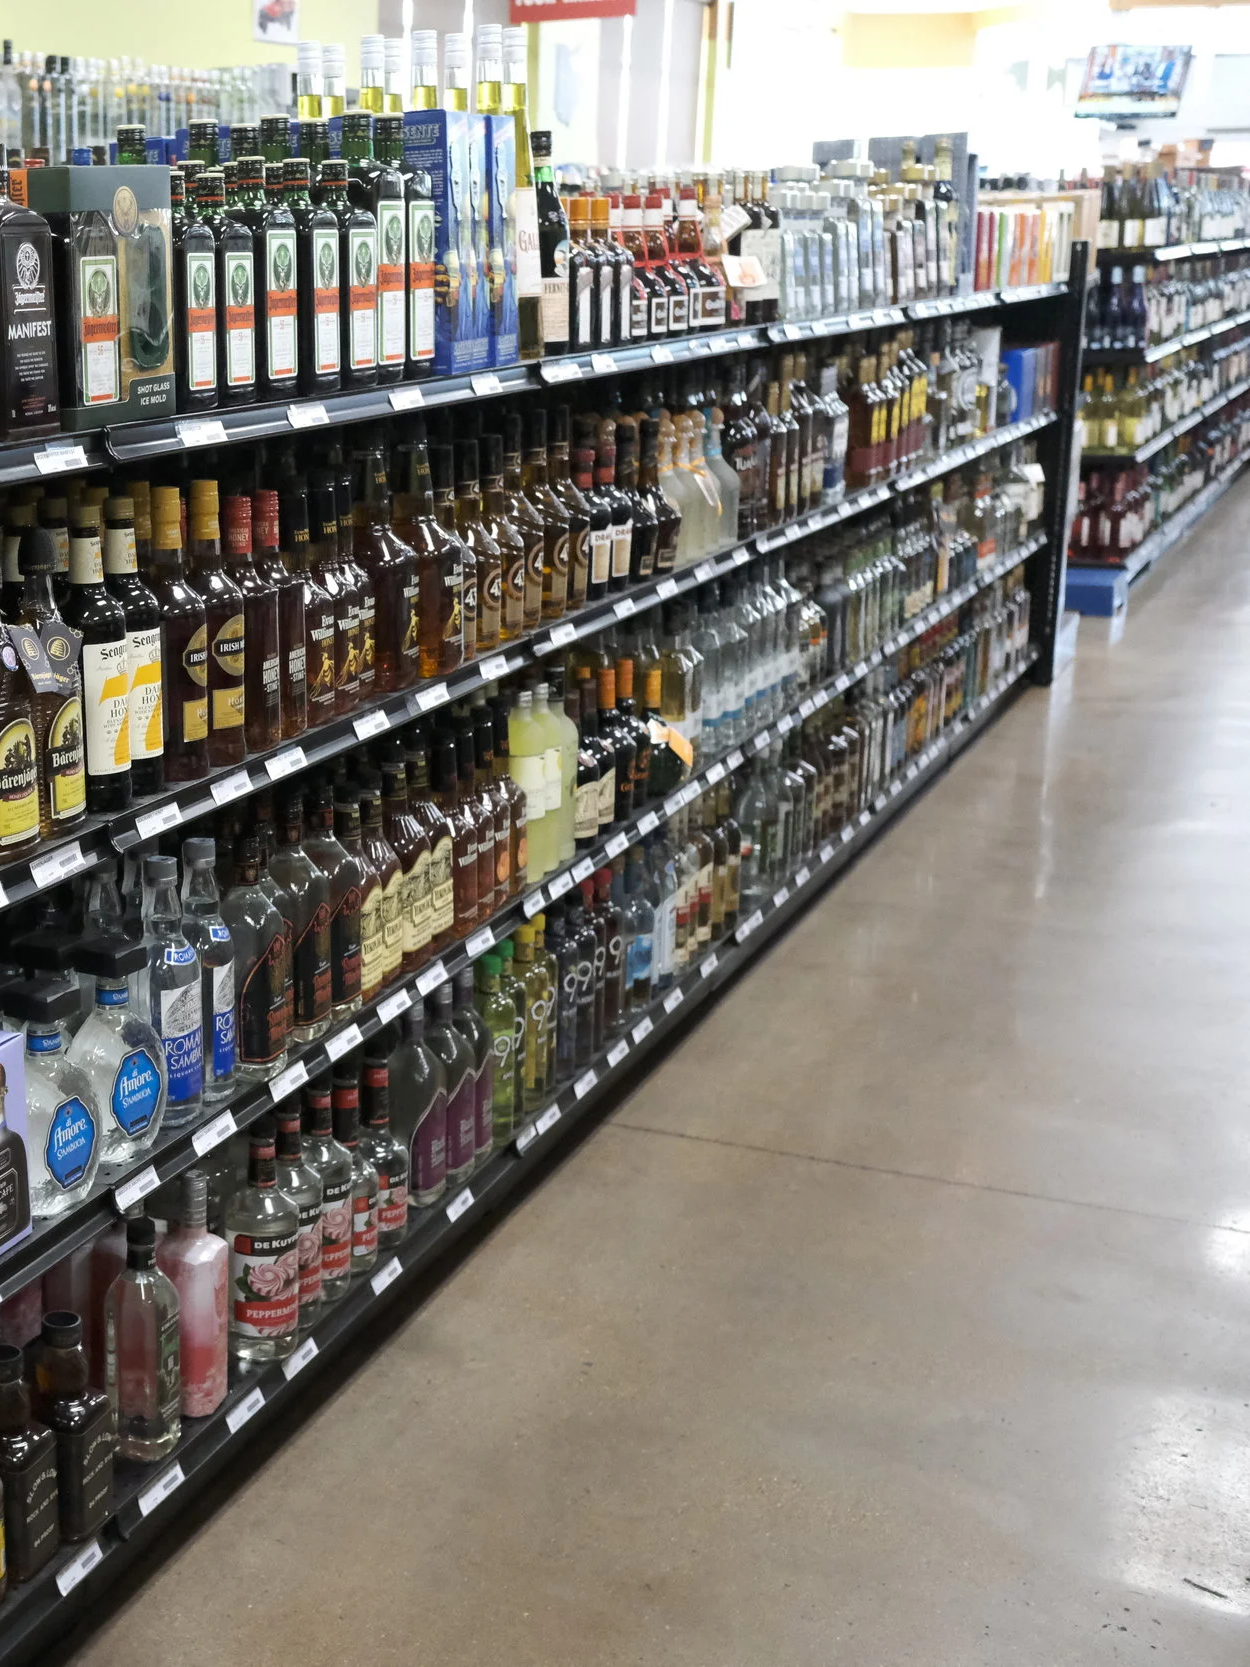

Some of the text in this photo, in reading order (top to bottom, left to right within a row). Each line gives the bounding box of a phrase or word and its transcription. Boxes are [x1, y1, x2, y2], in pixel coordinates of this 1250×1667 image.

[8, 320, 52, 340] MANIFEST
[137, 381, 170, 394] SHOT GLASS
[140, 394, 167, 406] ICE MOLD
[220, 641, 239, 653] IRISH
[123, 1087, 152, 1109] SAMBUCA
[56, 1137, 86, 1161] SAMBUCA
[254, 1234, 298, 1249] DE KUYP
